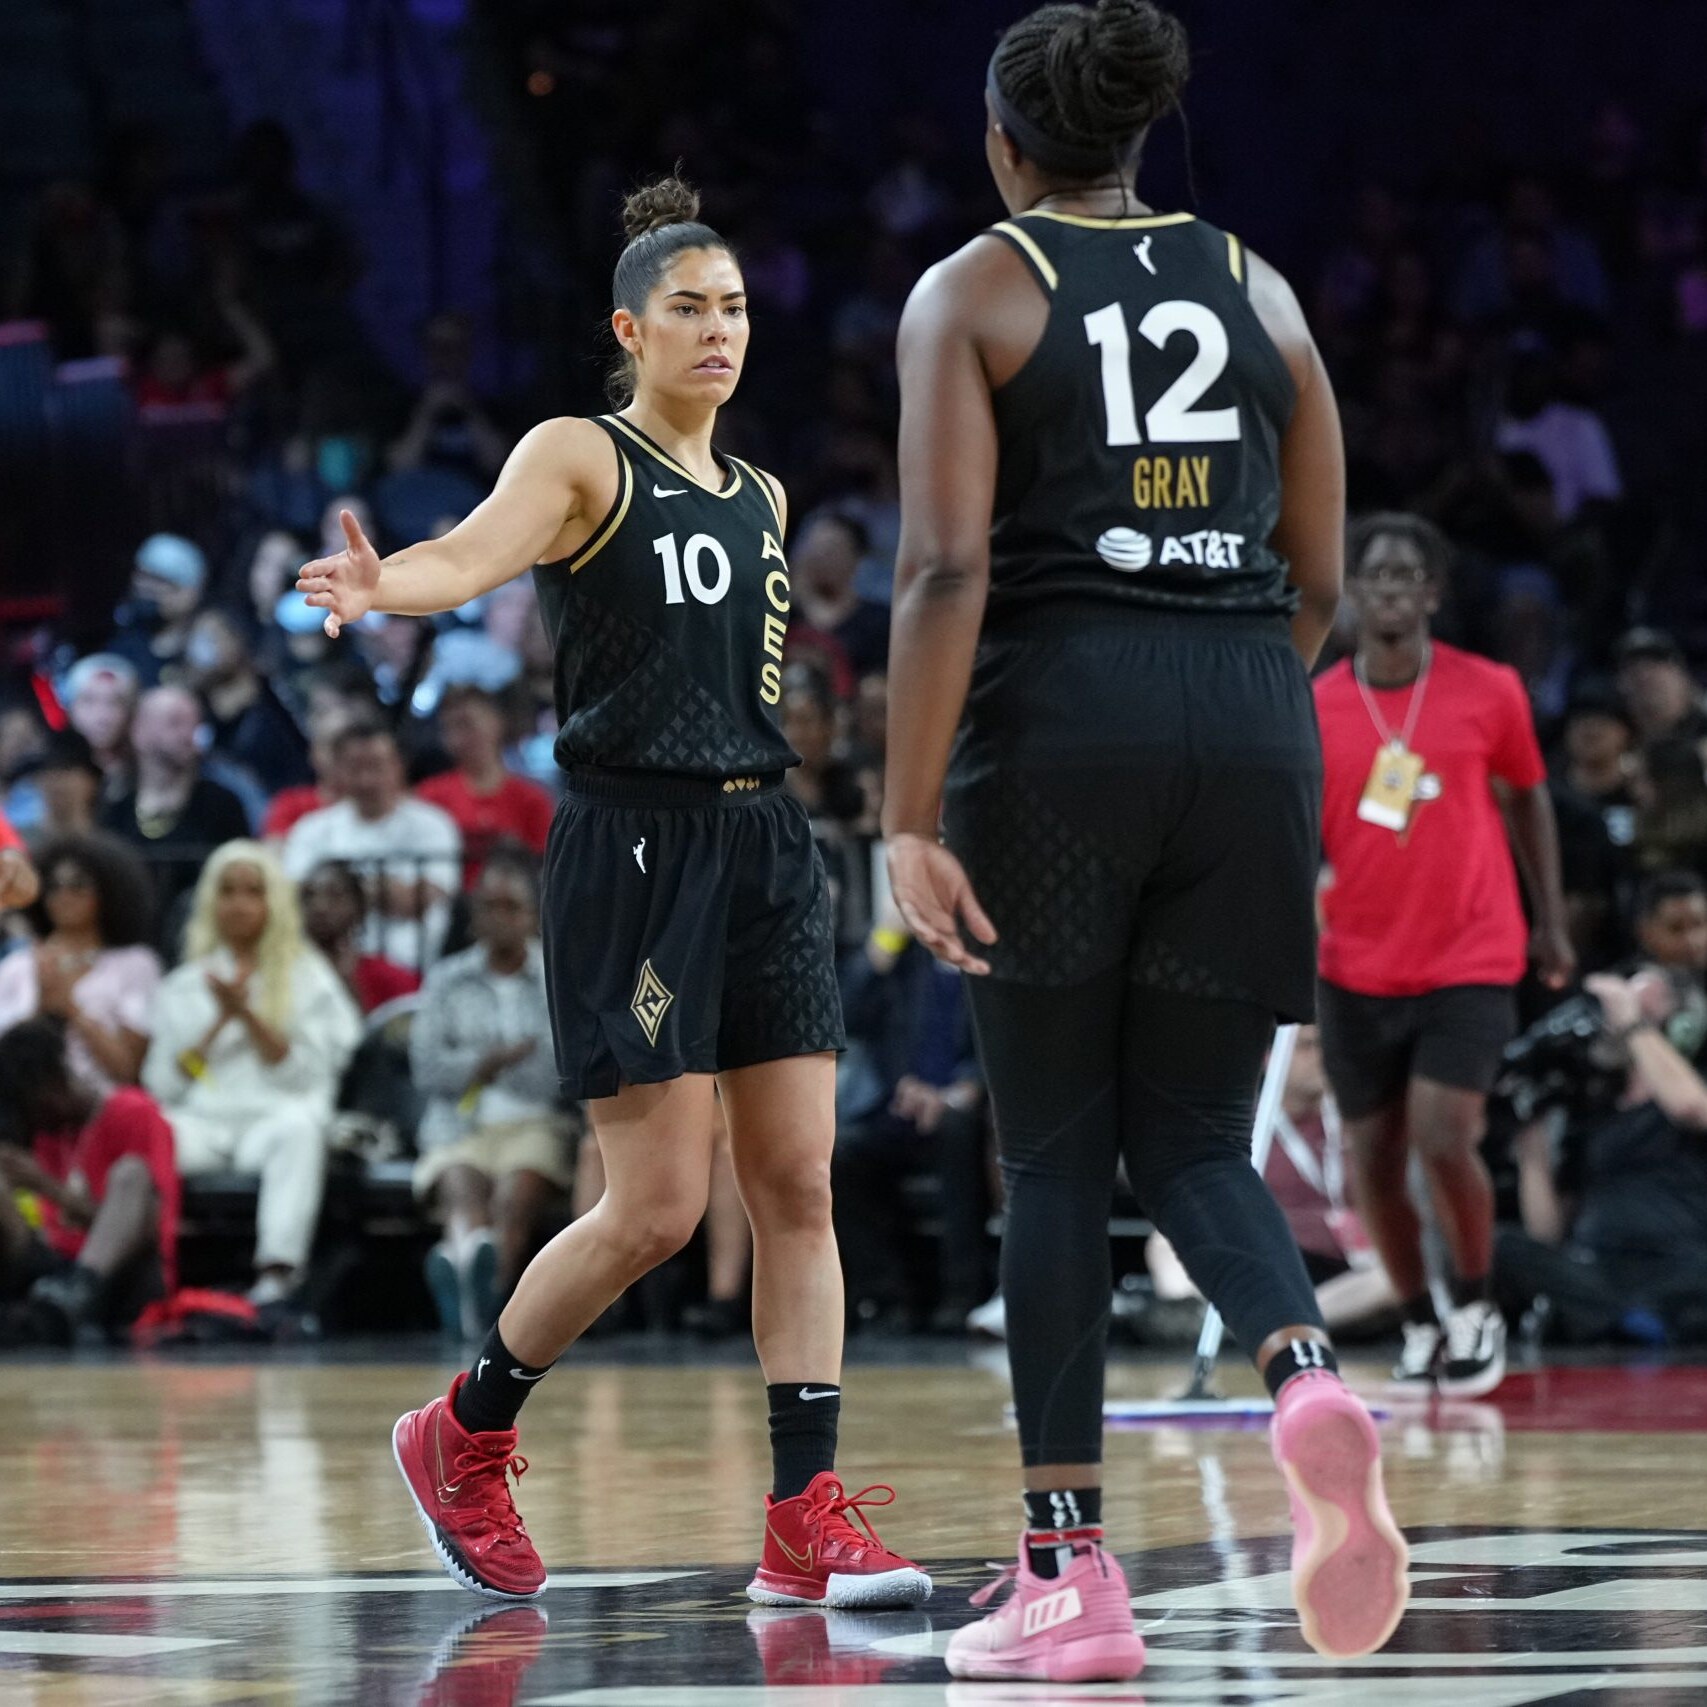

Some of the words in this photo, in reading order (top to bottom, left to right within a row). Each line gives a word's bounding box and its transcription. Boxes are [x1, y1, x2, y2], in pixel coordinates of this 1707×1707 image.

[1083, 300, 1240, 446] 12
[1133, 456, 1210, 509] GRAY
[652, 532, 731, 605] 10
[1159, 529, 1246, 570] AT&T
[759, 530, 790, 705] ACES
